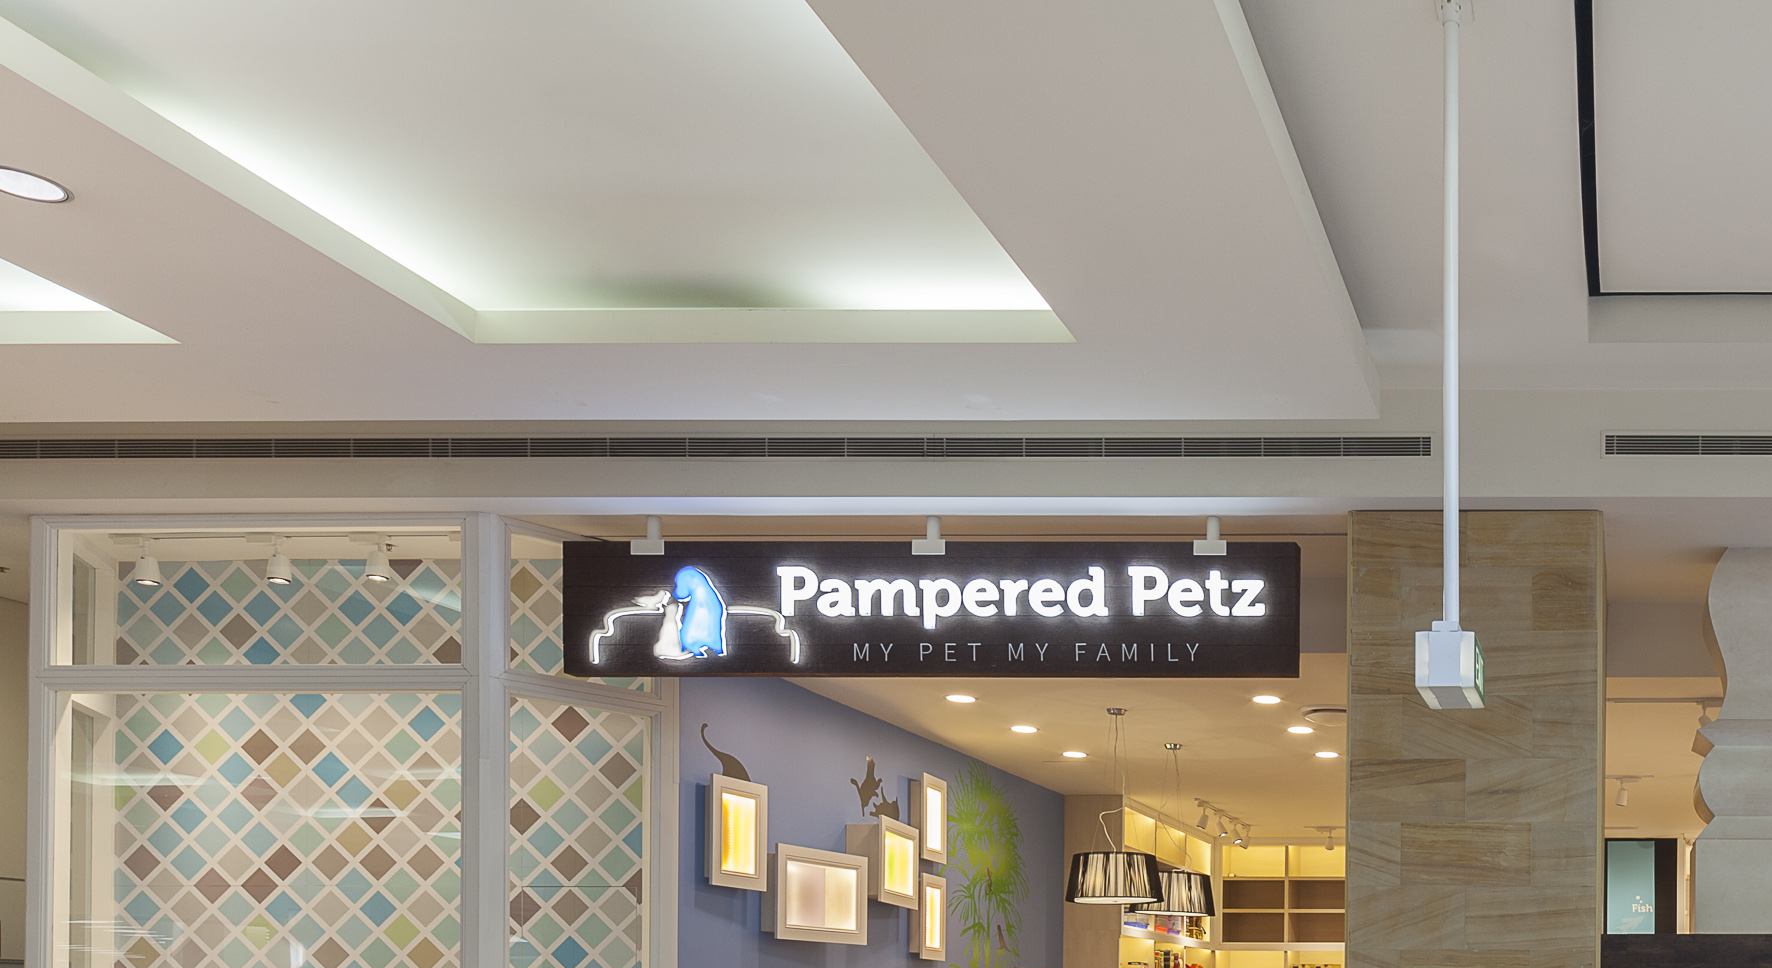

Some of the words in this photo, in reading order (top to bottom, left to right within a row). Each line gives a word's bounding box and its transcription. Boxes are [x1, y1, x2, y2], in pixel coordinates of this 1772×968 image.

[776, 565, 1109, 630] Pampered
[1127, 565, 1266, 617] Petz
[852, 642, 894, 662] MY
[918, 642, 982, 662] PET
[1007, 642, 1049, 662] MY
[1074, 642, 1200, 662] FAMILY
[1631, 903, 1654, 913] Fish
